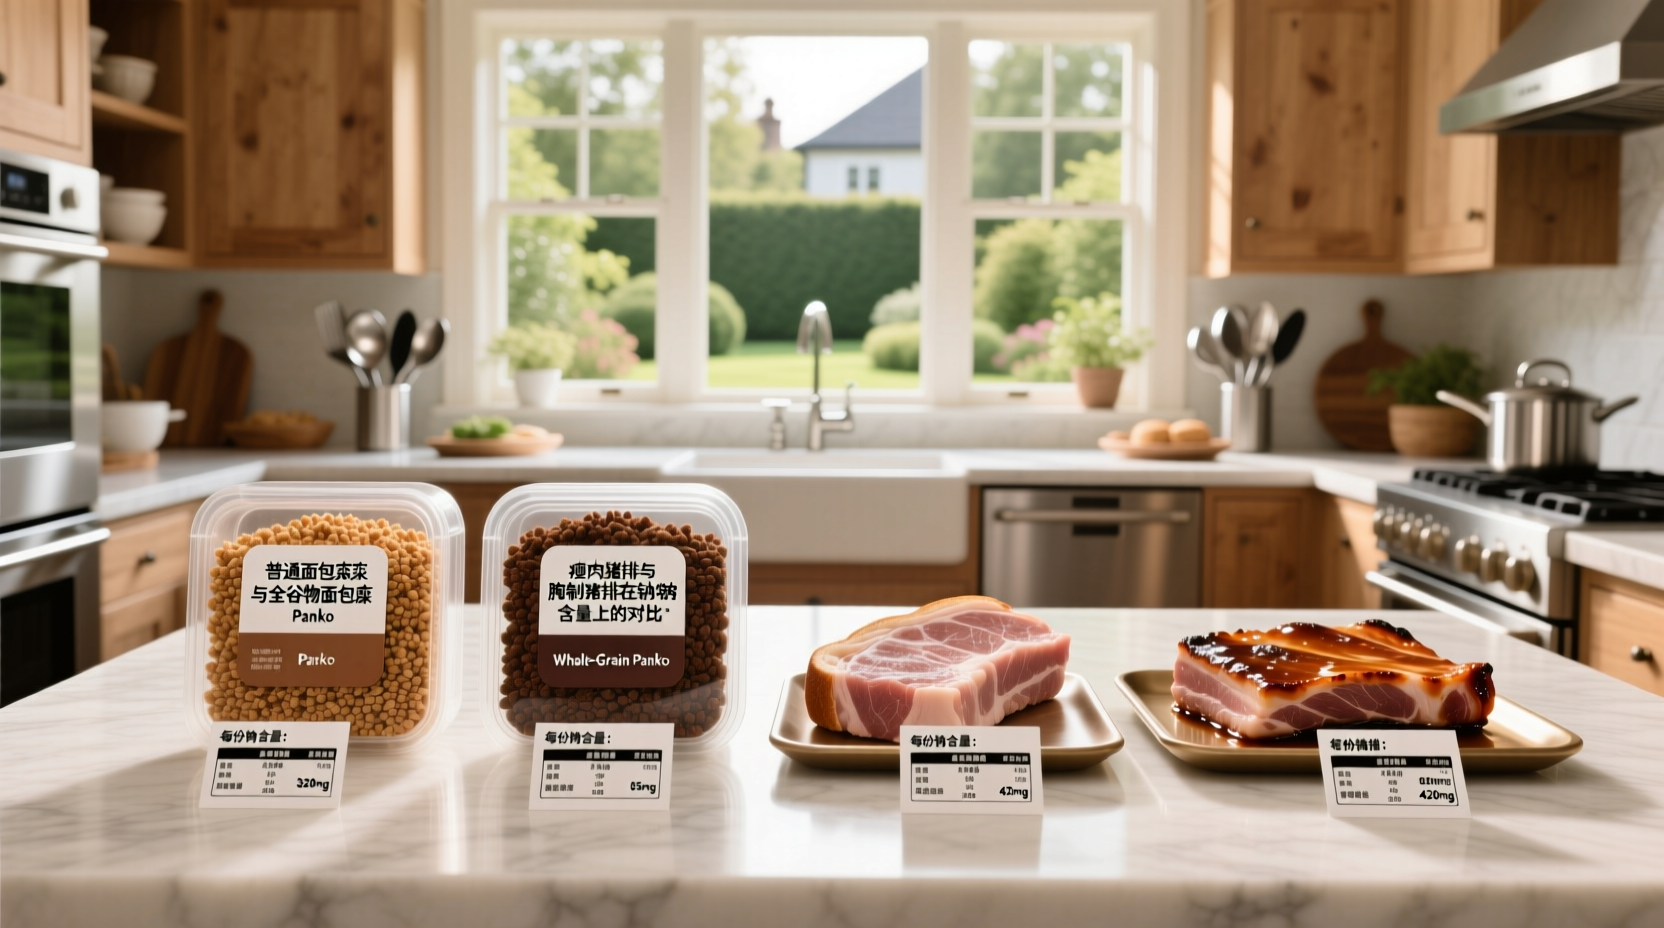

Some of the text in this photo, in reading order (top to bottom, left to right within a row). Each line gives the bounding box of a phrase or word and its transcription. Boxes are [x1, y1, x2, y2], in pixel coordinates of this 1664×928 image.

[292, 608, 334, 623] Panko
[633, 653, 670, 666] Panko
[1419, 790, 1455, 803] 420mg
